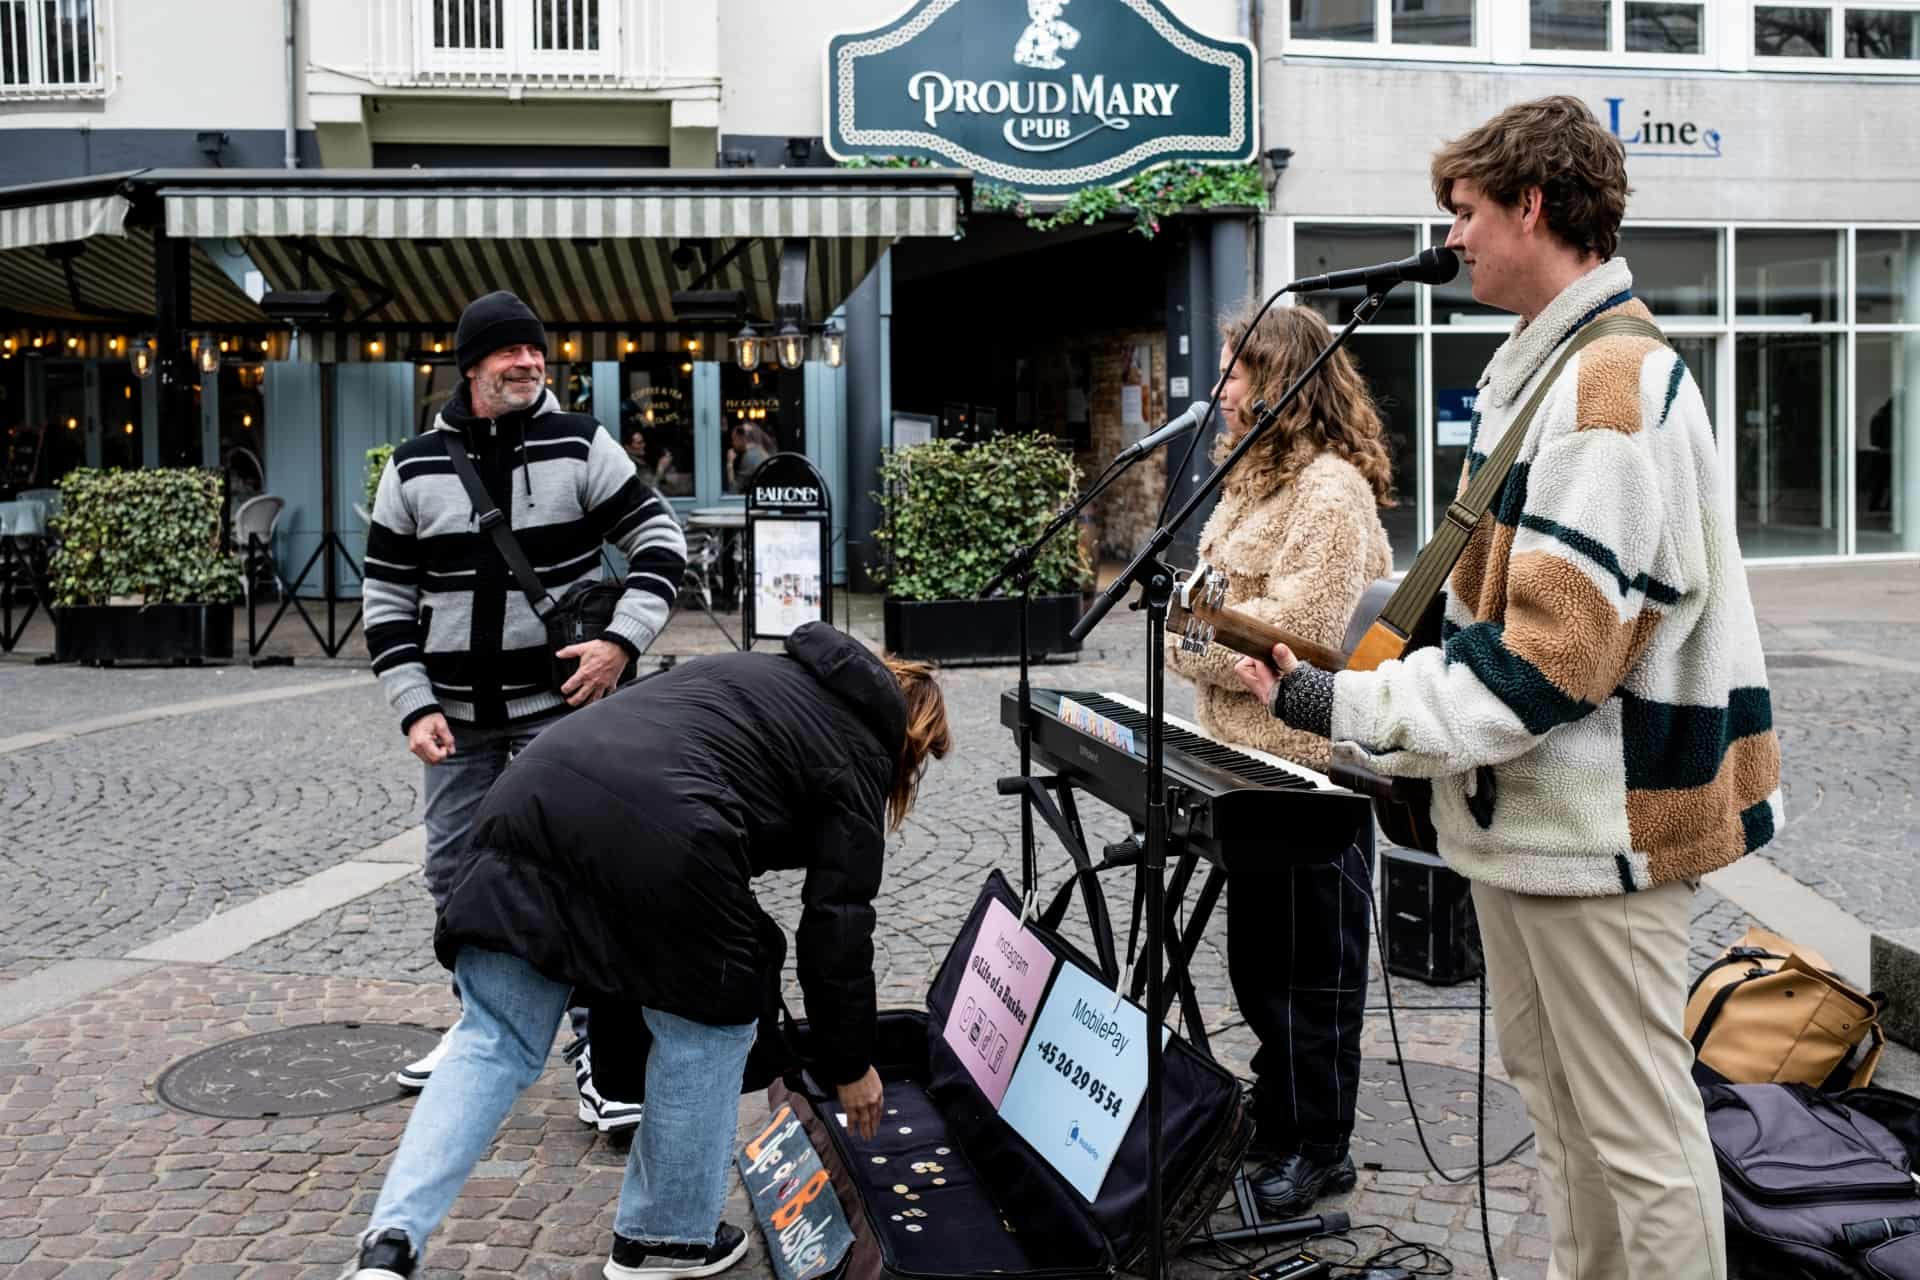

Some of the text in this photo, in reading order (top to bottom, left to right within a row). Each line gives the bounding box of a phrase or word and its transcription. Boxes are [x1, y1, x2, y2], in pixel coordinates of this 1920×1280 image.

[908, 71, 1180, 128] PROUD MARY
[1604, 97, 1698, 145] Line
[1021, 119, 1071, 138] PUB
[1071, 998, 1129, 1057] MobilePay
[1038, 1040, 1123, 1118] +45 26 29 95 54
